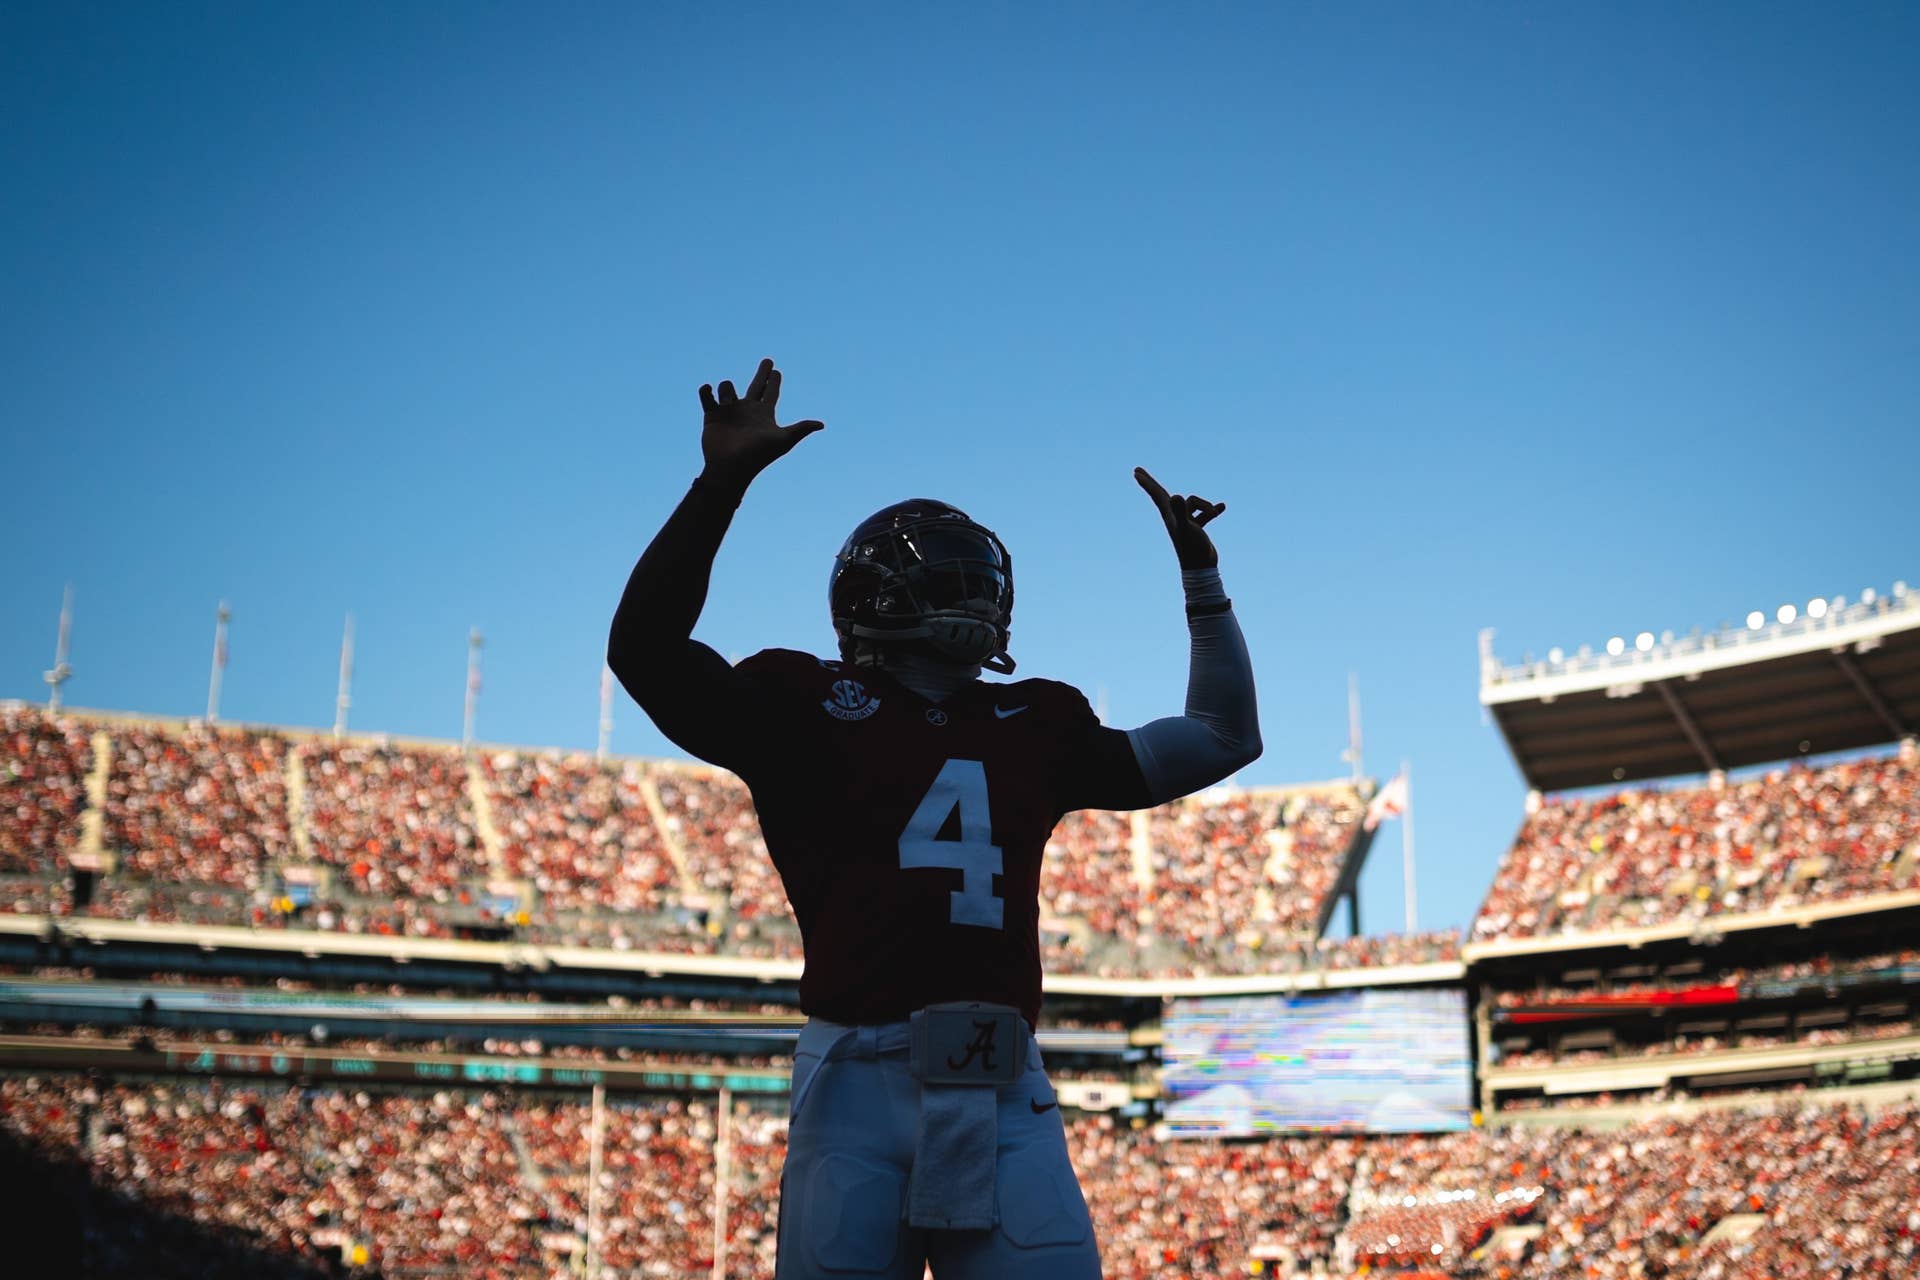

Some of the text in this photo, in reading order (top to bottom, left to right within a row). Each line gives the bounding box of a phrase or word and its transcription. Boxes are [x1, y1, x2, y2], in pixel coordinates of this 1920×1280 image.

[829, 704, 876, 720] GRADUATE
[832, 679, 868, 708] SEC
[898, 758, 1004, 930] 4
[947, 1016, 998, 1072] A
